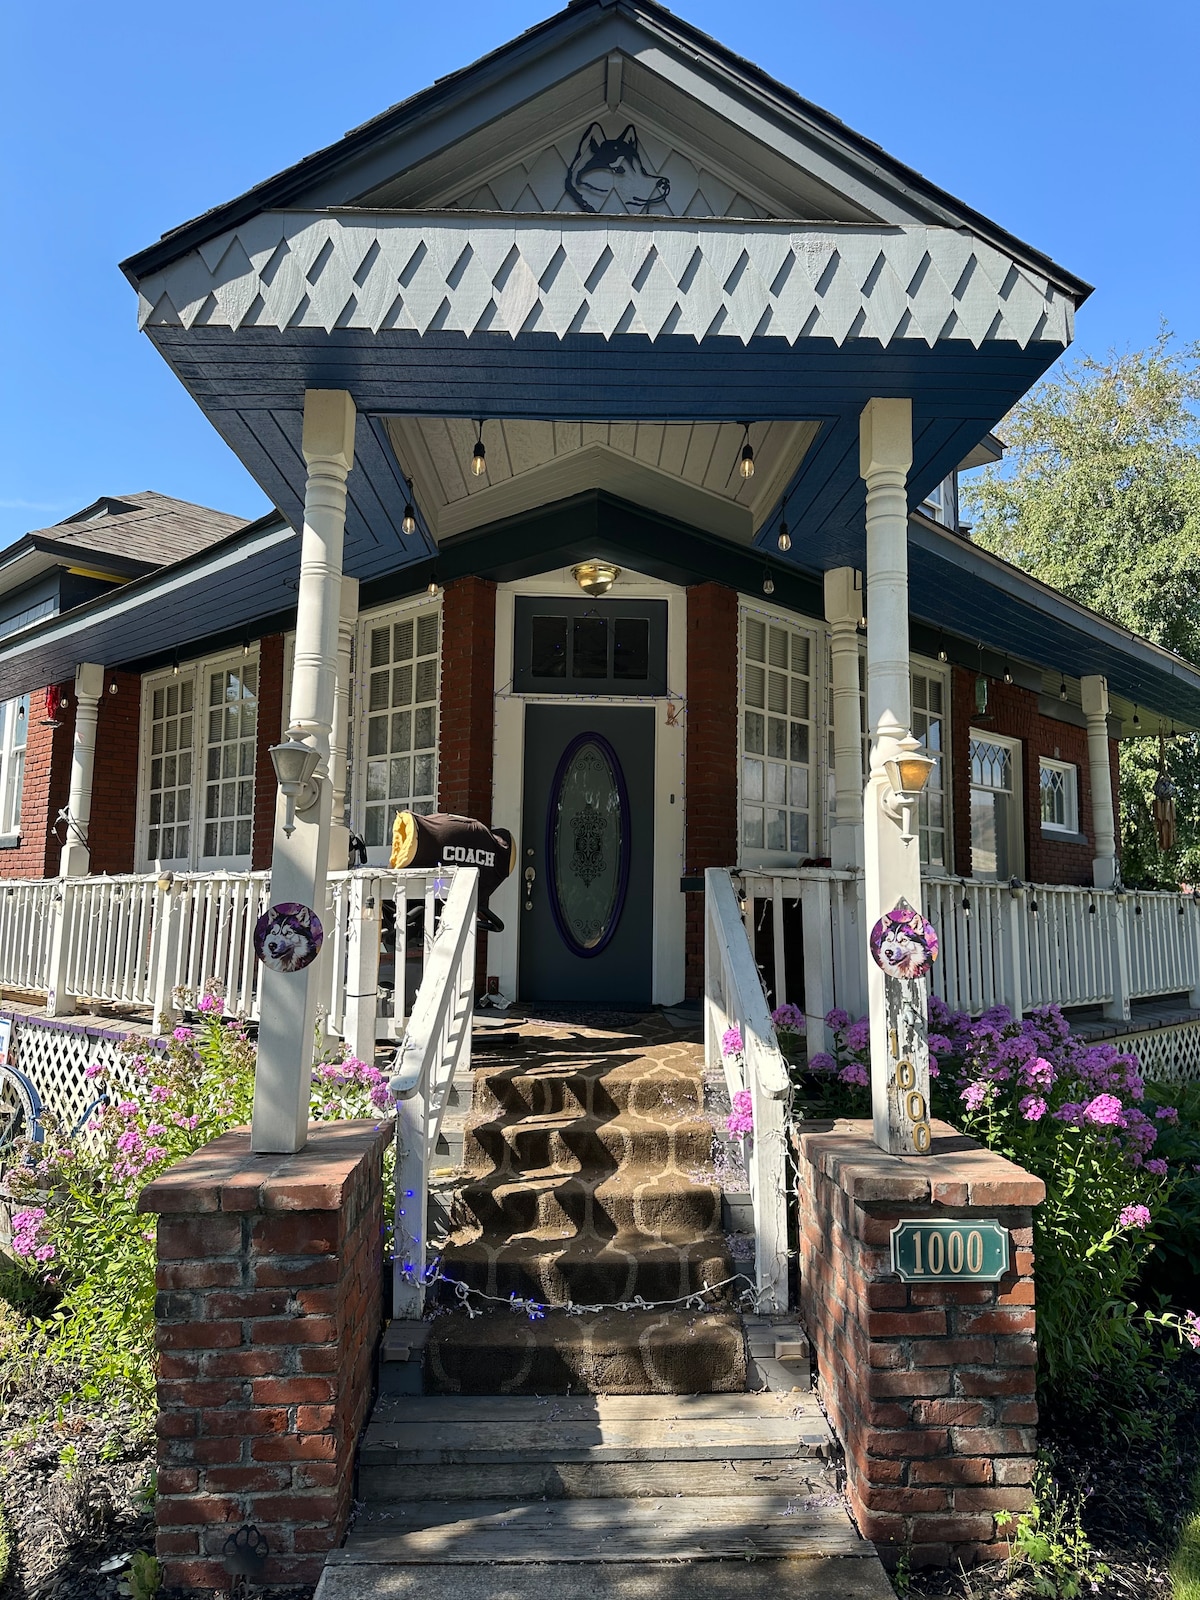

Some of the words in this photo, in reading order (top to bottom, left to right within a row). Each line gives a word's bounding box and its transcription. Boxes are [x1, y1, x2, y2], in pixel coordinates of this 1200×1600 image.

[443, 845, 495, 867] COACH
[889, 1028, 931, 1152] 1000
[912, 1230, 984, 1274] 1000
